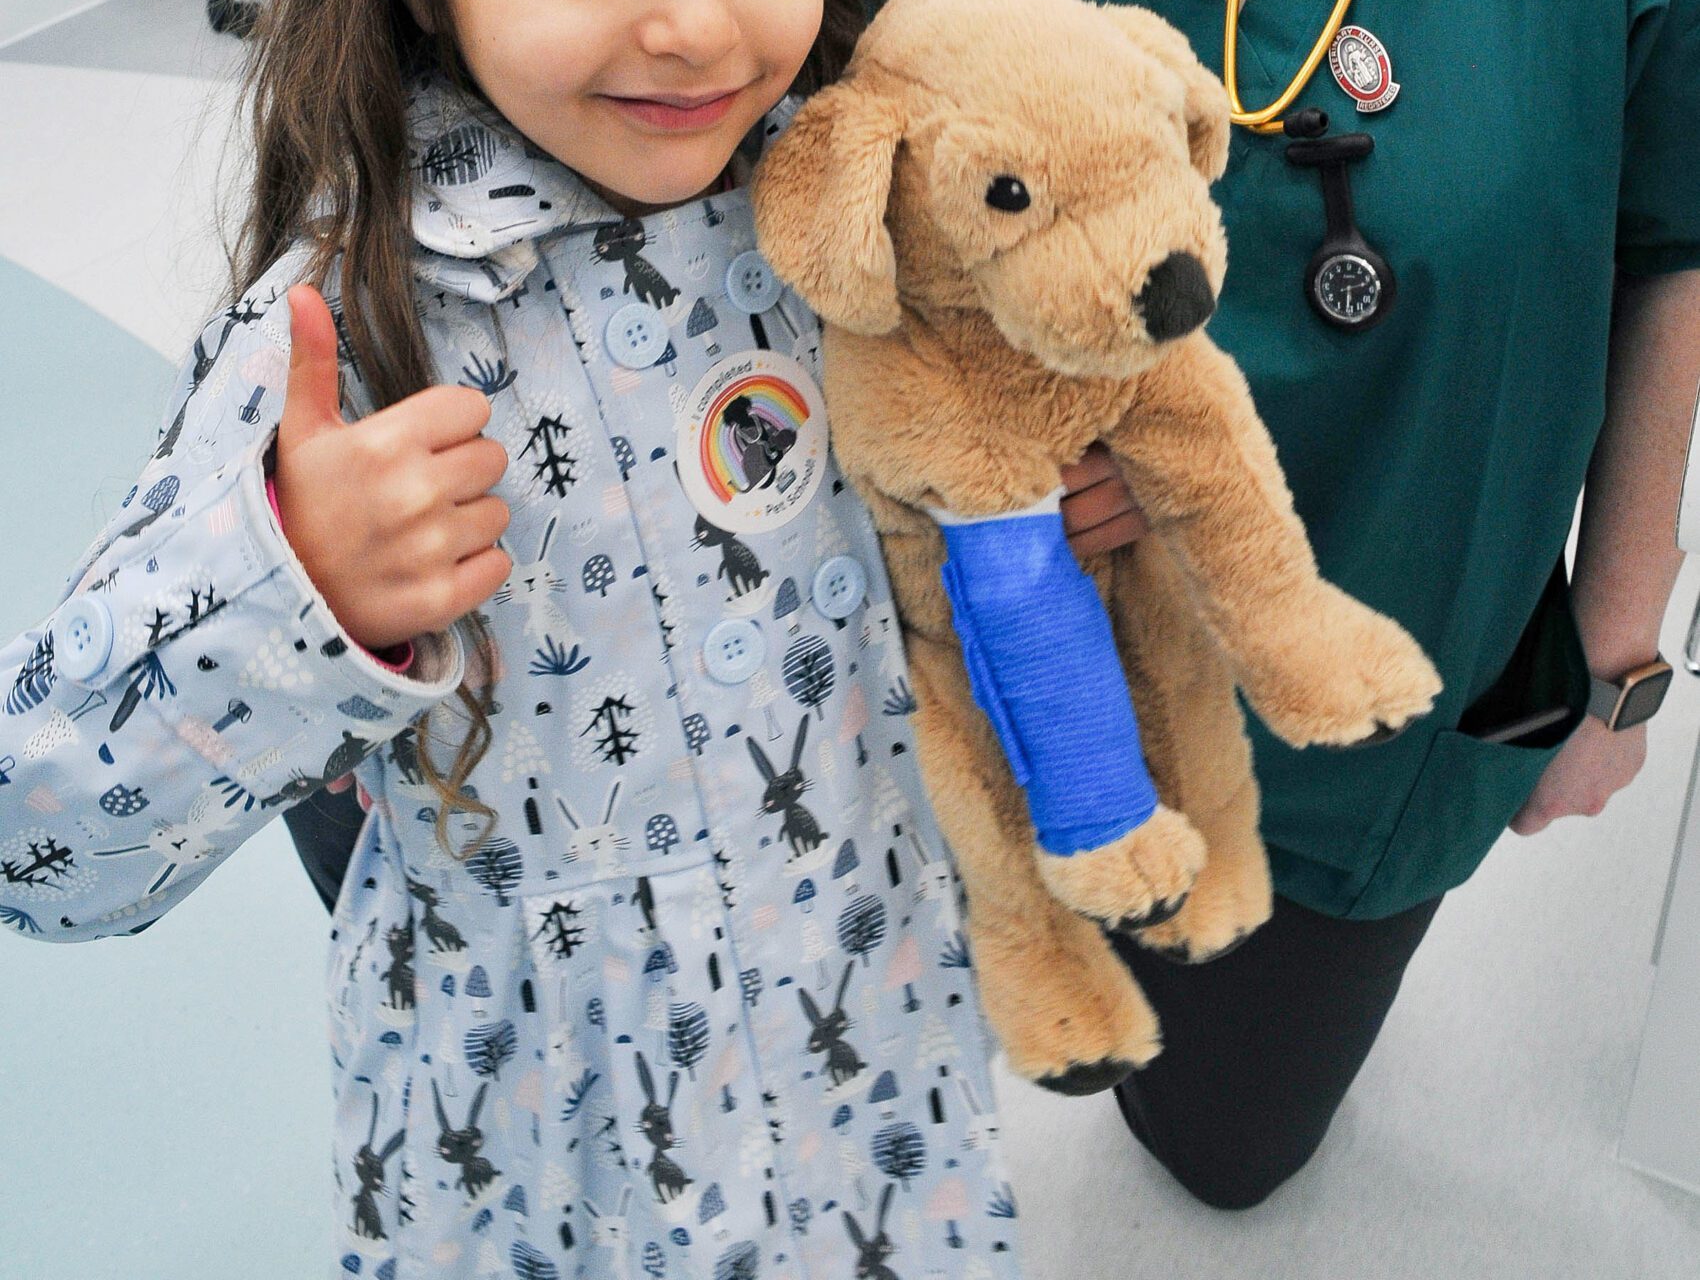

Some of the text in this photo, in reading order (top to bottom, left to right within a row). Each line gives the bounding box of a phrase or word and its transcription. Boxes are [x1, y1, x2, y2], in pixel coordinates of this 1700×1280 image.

[1330, 28, 1383, 81] VETERINARY NURSE
[1358, 85, 1398, 111] REGISTERED
[1356, 302, 1364, 311] 11
[1362, 295, 1371, 304] 10
[699, 359, 754, 413] completed
[765, 500, 786, 517] Pet
